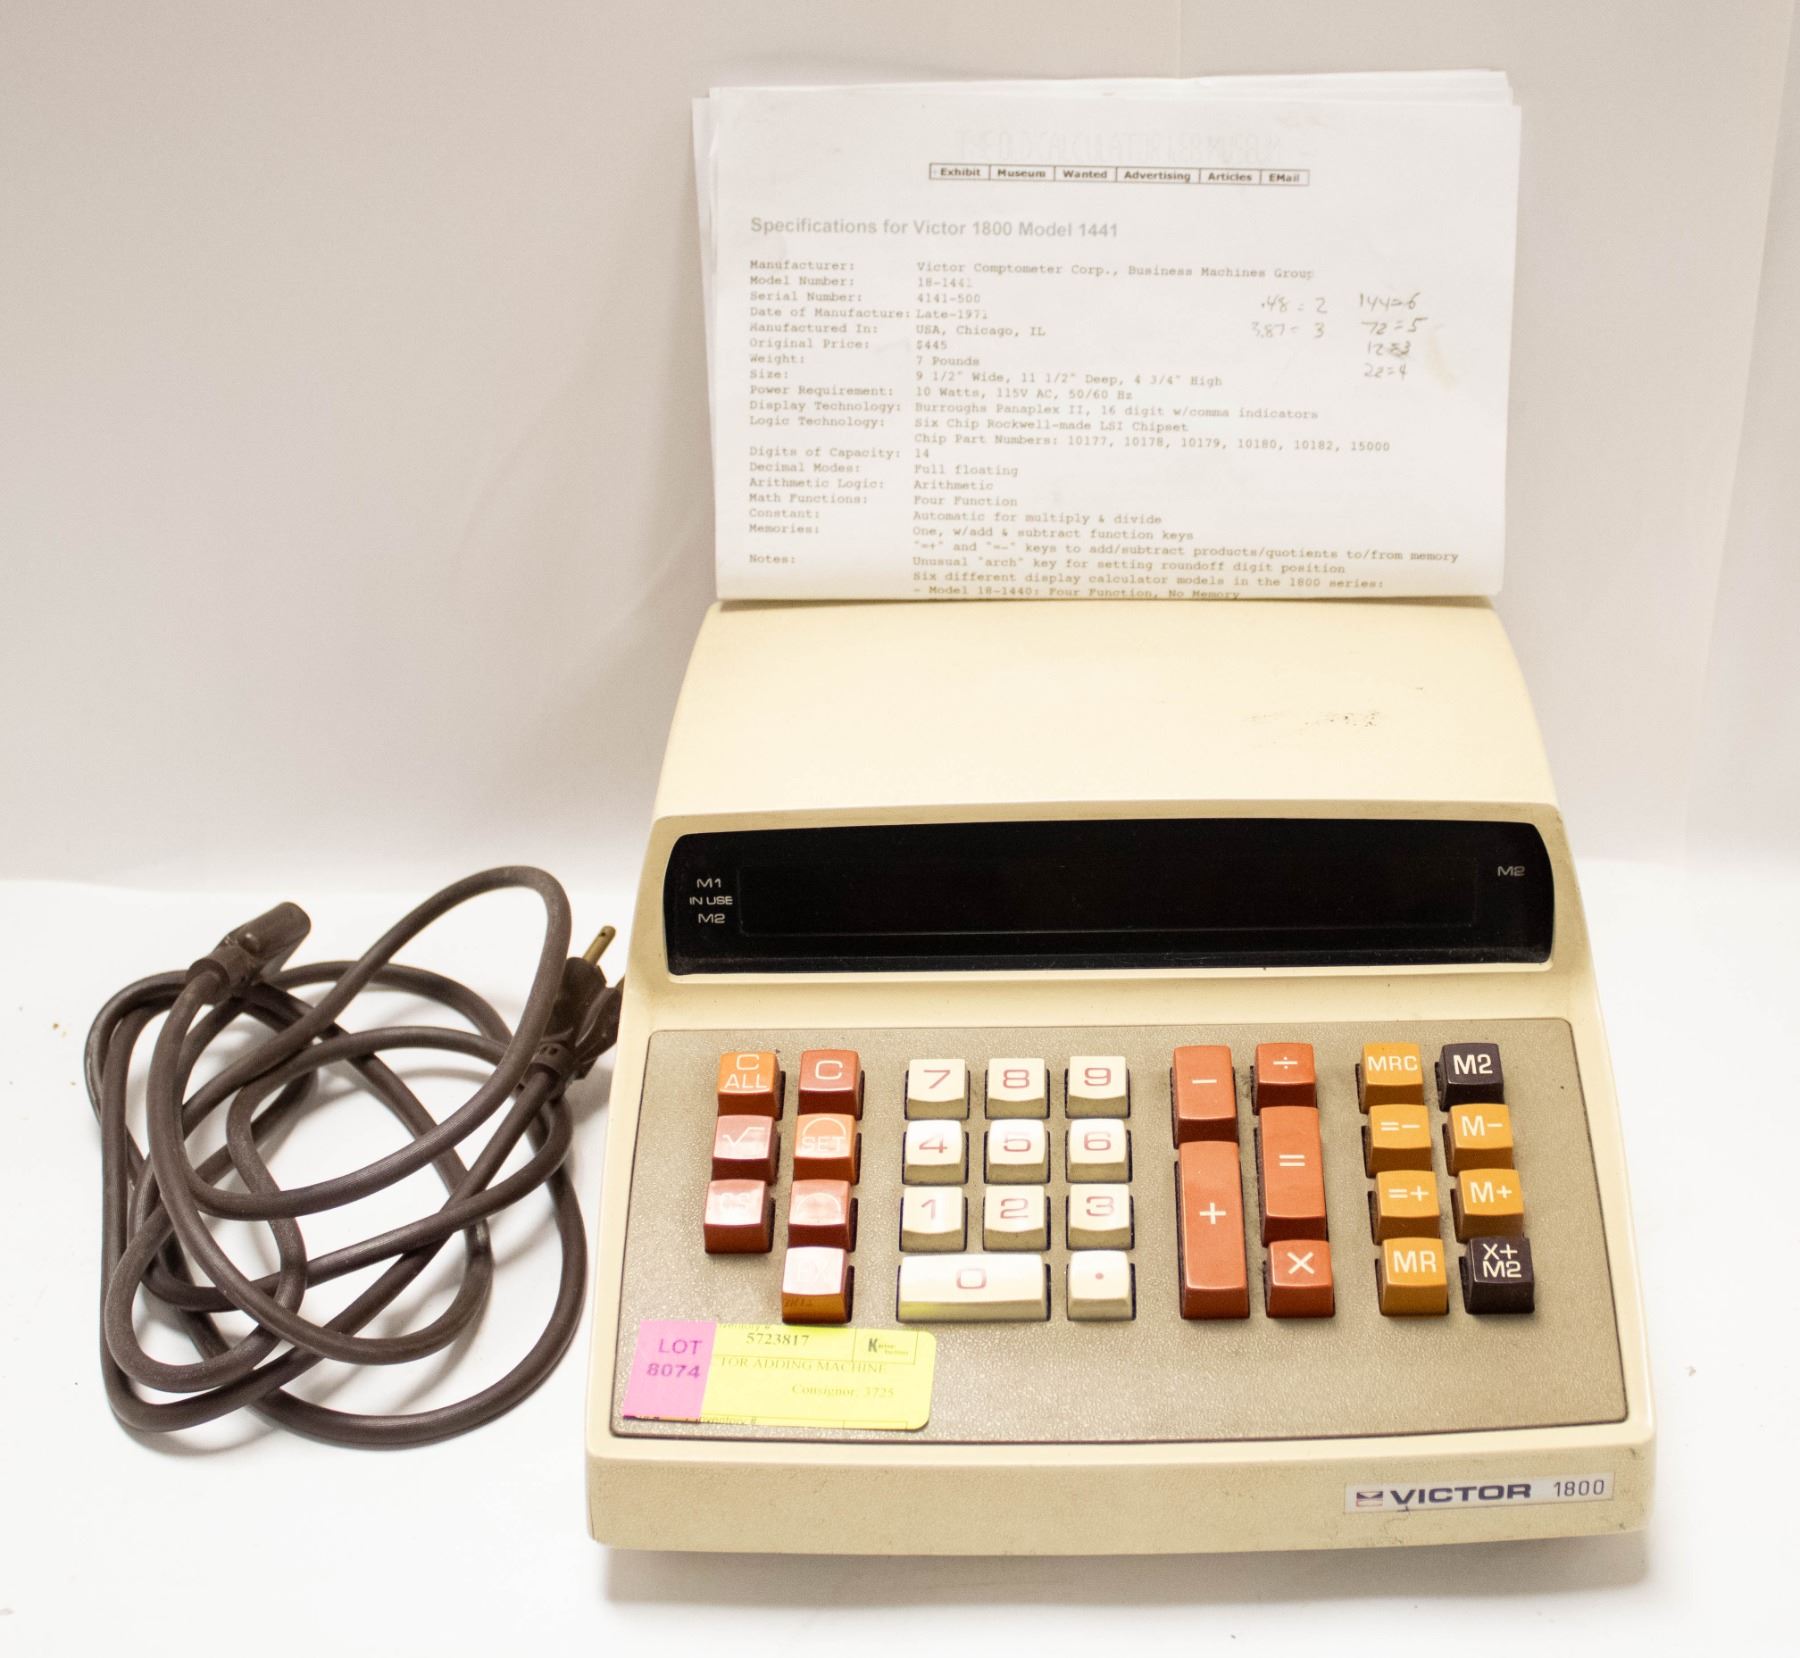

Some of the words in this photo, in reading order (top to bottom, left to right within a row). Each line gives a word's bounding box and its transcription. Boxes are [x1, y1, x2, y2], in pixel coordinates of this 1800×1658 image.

[940, 166, 981, 178] Exhibit
[998, 168, 1046, 178] Museum
[1063, 169, 1108, 180] Wanted
[1124, 170, 1191, 183] Advertising
[1207, 172, 1253, 182] Articles
[751, 217, 877, 236] Specifications
[883, 218, 909, 235] for
[913, 219, 966, 236] Victor
[972, 221, 1012, 237] 1800
[1018, 222, 1072, 238] Model
[1079, 223, 1118, 238] 1441
[749, 260, 854, 271] Manufacturer:
[916, 262, 966, 273] Victor
[973, 263, 1064, 276] Comptometer
[1127, 265, 1194, 276] Business
[1200, 267, 1266, 277] Machines
[749, 275, 790, 286] Model
[798, 276, 854, 287] Number:
[749, 291, 798, 302] Serial
[806, 292, 862, 302] Number:
[749, 307, 782, 317] Date
[814, 307, 910, 318] Manufacture:
[749, 338, 814, 351] Original
[822, 339, 870, 350] Price:
[931, 356, 980, 367] Pounds
[749, 369, 788, 380] Size:
[1189, 376, 1224, 389] High
[749, 384, 790, 395] Power
[797, 385, 894, 398] Requirement:
[1068, 389, 1110, 400] 50/60
[749, 400, 806, 413] Display
[814, 401, 902, 414] Technology:
[995, 404, 1060, 417] Panaplex
[1124, 406, 1164, 419] digit
[1238, 408, 1319, 419] indicators
[749, 416, 790, 429] Logic
[797, 416, 886, 430] Technology:
[914, 418, 940, 428] Six
[946, 418, 980, 431] Chip
[986, 419, 1092, 430] Rockwell-made
[1099, 420, 1124, 431] LSI
[1131, 421, 1188, 434] Chipset
[914, 433, 948, 446] Chip
[954, 434, 988, 445] Part
[994, 435, 1058, 446] Numbers:
[1350, 441, 1390, 451] 15000
[749, 446, 798, 459] Digits
[828, 447, 900, 461] Capacity:
[749, 462, 806, 473] Decimal
[813, 463, 860, 473] Modes:
[913, 464, 946, 475] Full
[954, 465, 1020, 478] floating
[749, 478, 830, 489] Arithmetic
[837, 479, 884, 492] Logic:
[913, 480, 994, 491] Arithmetic
[748, 493, 782, 504] Math
[788, 493, 868, 504] Functions:
[953, 496, 1018, 506] Function
[748, 508, 820, 519] Constant:
[912, 511, 986, 522] Automatic
[1024, 513, 1092, 526] multiply
[1113, 514, 1164, 525] divide
[748, 524, 820, 535] Memories:
[1017, 528, 1082, 539] subtract
[1090, 529, 1154, 539] function
[1161, 529, 1194, 542] keys
[748, 554, 796, 565] Notes:
[1089, 544, 1186, 555] add/subtract
[1346, 548, 1404, 559] to/from
[1409, 551, 1460, 563] memory
[912, 556, 968, 567] Unusual
[1097, 559, 1154, 572] setting
[1160, 560, 1226, 571] roundoff
[1232, 561, 1274, 575] digit
[1280, 562, 1346, 575] position
[943, 572, 1016, 583] different
[1024, 573, 1082, 586] display
[1088, 574, 1168, 585] calculator
[1176, 575, 1226, 586] models
[1289, 577, 1322, 588] 1800
[1328, 578, 1384, 588] series:
[928, 584, 968, 595] Model
[1497, 865, 1526, 877] M2
[696, 877, 721, 888] M1
[689, 896, 703, 905] IN
[706, 896, 733, 906] USE
[698, 913, 726, 924] M2
[736, 1053, 760, 1071] C
[1367, 1055, 1418, 1072] MRC
[1453, 1054, 1494, 1075] M2
[815, 1060, 844, 1080] C
[1083, 1067, 1112, 1086] 9
[724, 1073, 768, 1089] ALL
[923, 1069, 951, 1089] 7
[1002, 1069, 1030, 1089] 8
[801, 1136, 846, 1152] SET
[918, 1133, 948, 1154] 4
[1003, 1132, 1032, 1153] 5
[1083, 1131, 1112, 1152] 6
[1470, 1181, 1513, 1203] M+
[921, 1199, 937, 1220] 1
[1000, 1198, 1029, 1219] 2
[1085, 1196, 1115, 1217] 3
[1393, 1250, 1437, 1274] MR
[1482, 1260, 1522, 1279] M2
[746, 1332, 810, 1346] 5723817
[658, 1338, 703, 1355] LOT
[647, 1363, 701, 1379] 8074
[752, 1358, 813, 1371] ADDING
[816, 1360, 885, 1374] MACHINE
[1390, 1483, 1532, 1505] VICTOR
[1553, 1479, 1605, 1497] 1800
